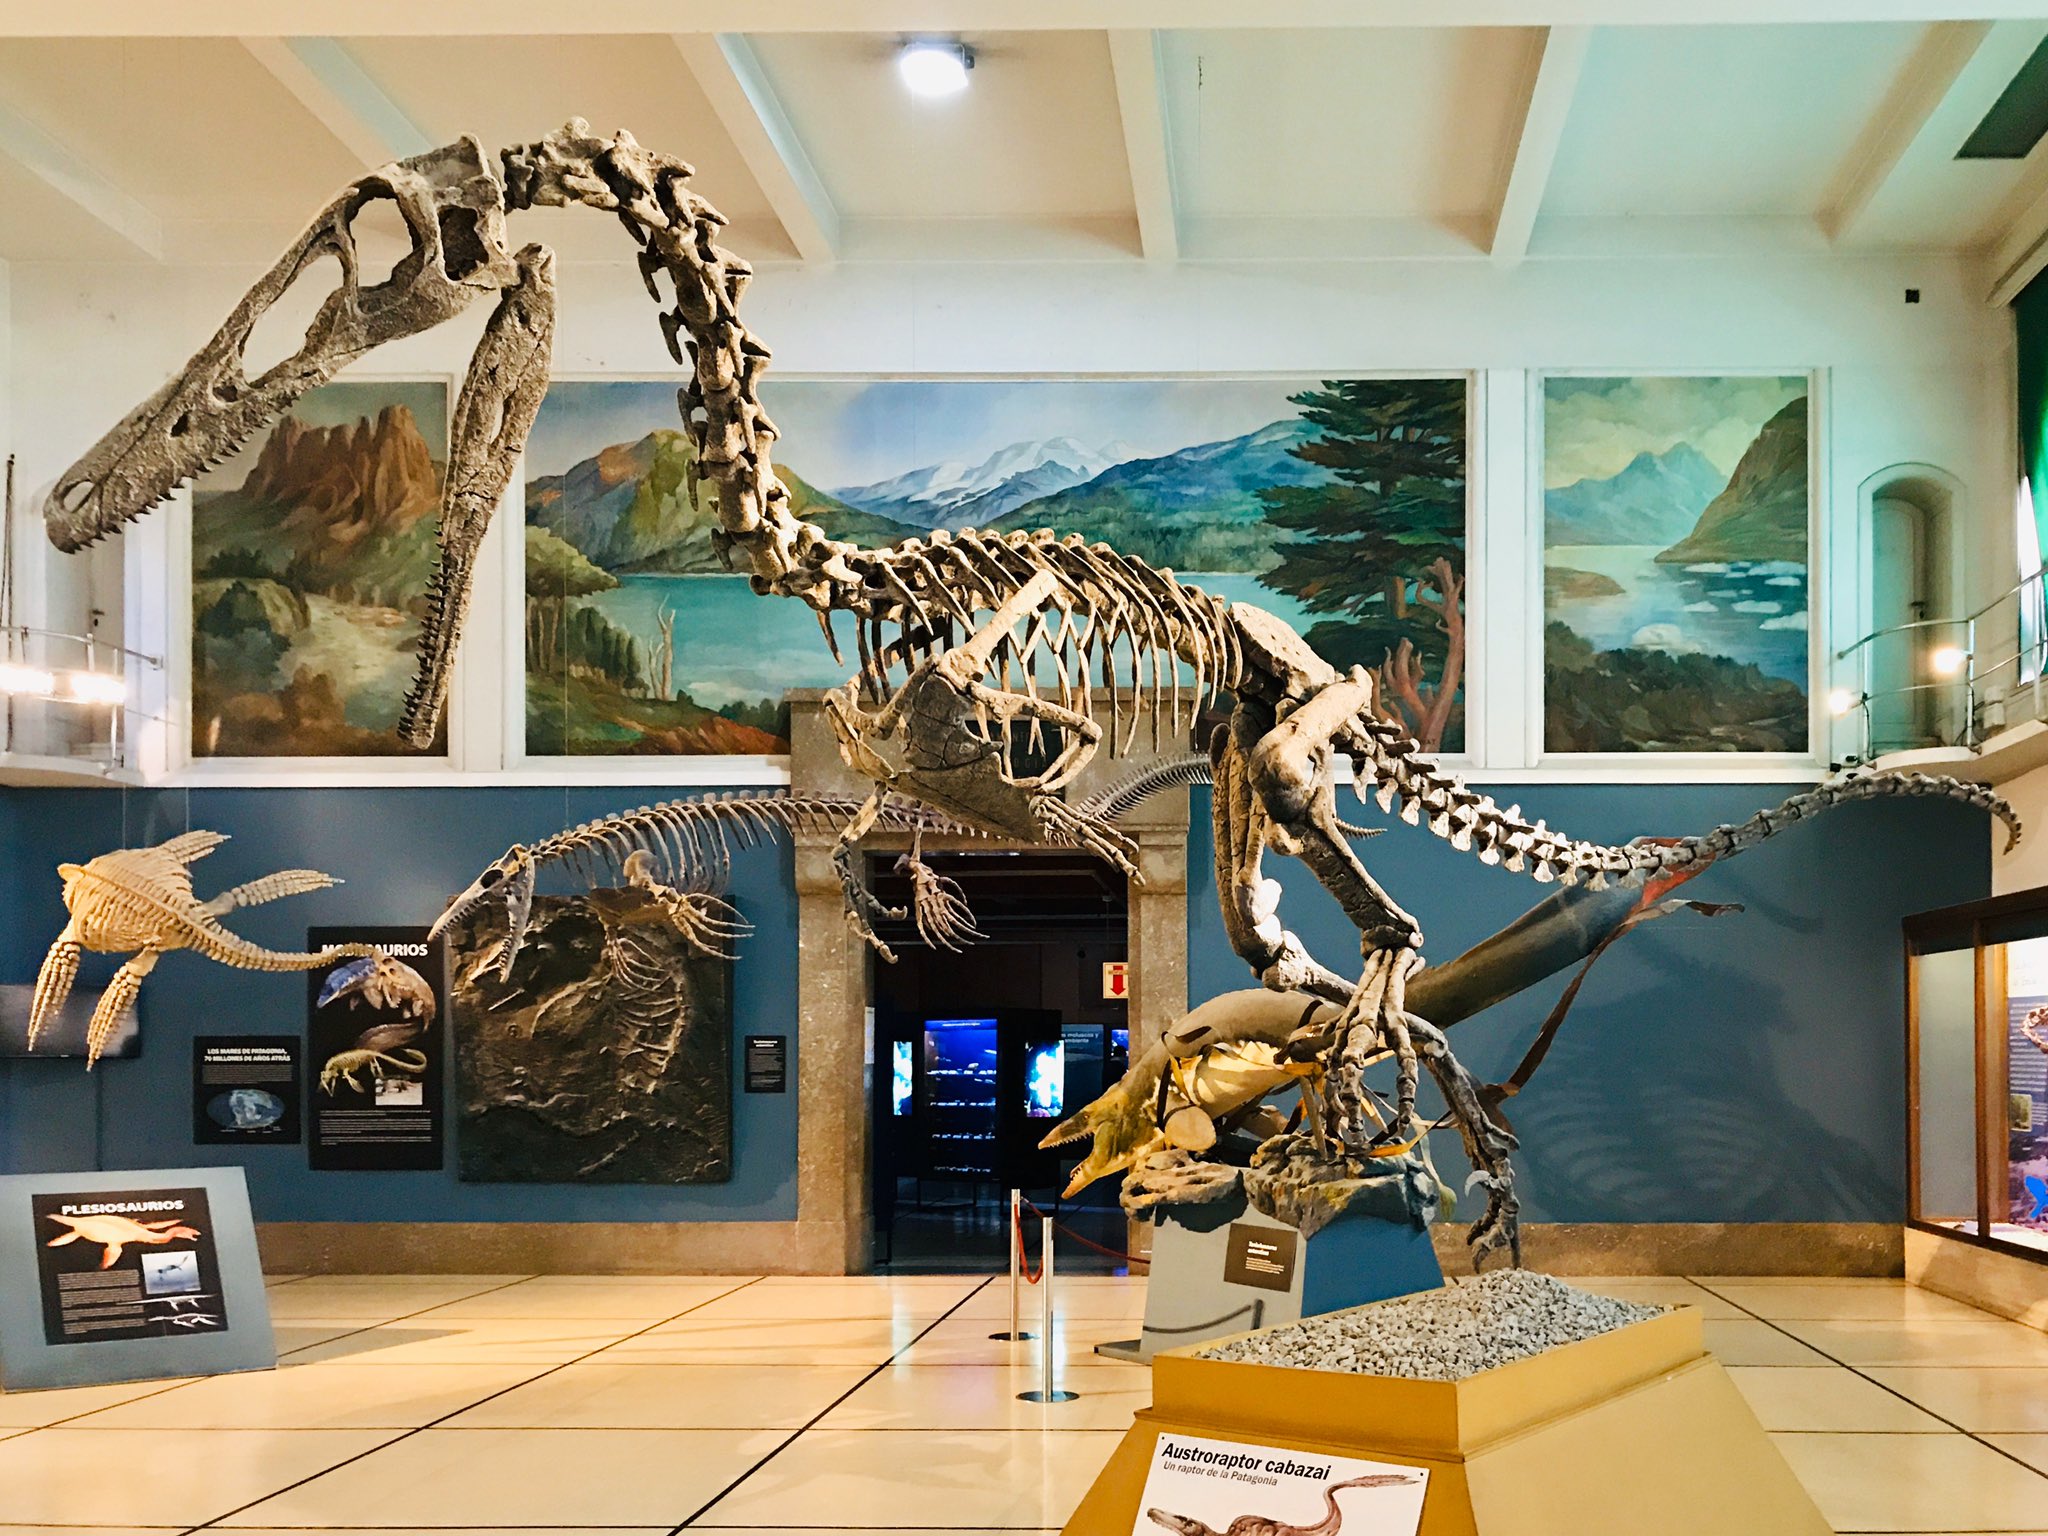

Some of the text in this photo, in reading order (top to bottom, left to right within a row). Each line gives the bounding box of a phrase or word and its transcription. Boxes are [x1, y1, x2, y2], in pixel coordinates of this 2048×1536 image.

[61, 1200, 185, 1215] PLESIOSAURIOS
[1161, 1442, 1332, 1481] Austroraptor cabazai
[1163, 1461, 1278, 1486] Un raptor de la Patagonia
